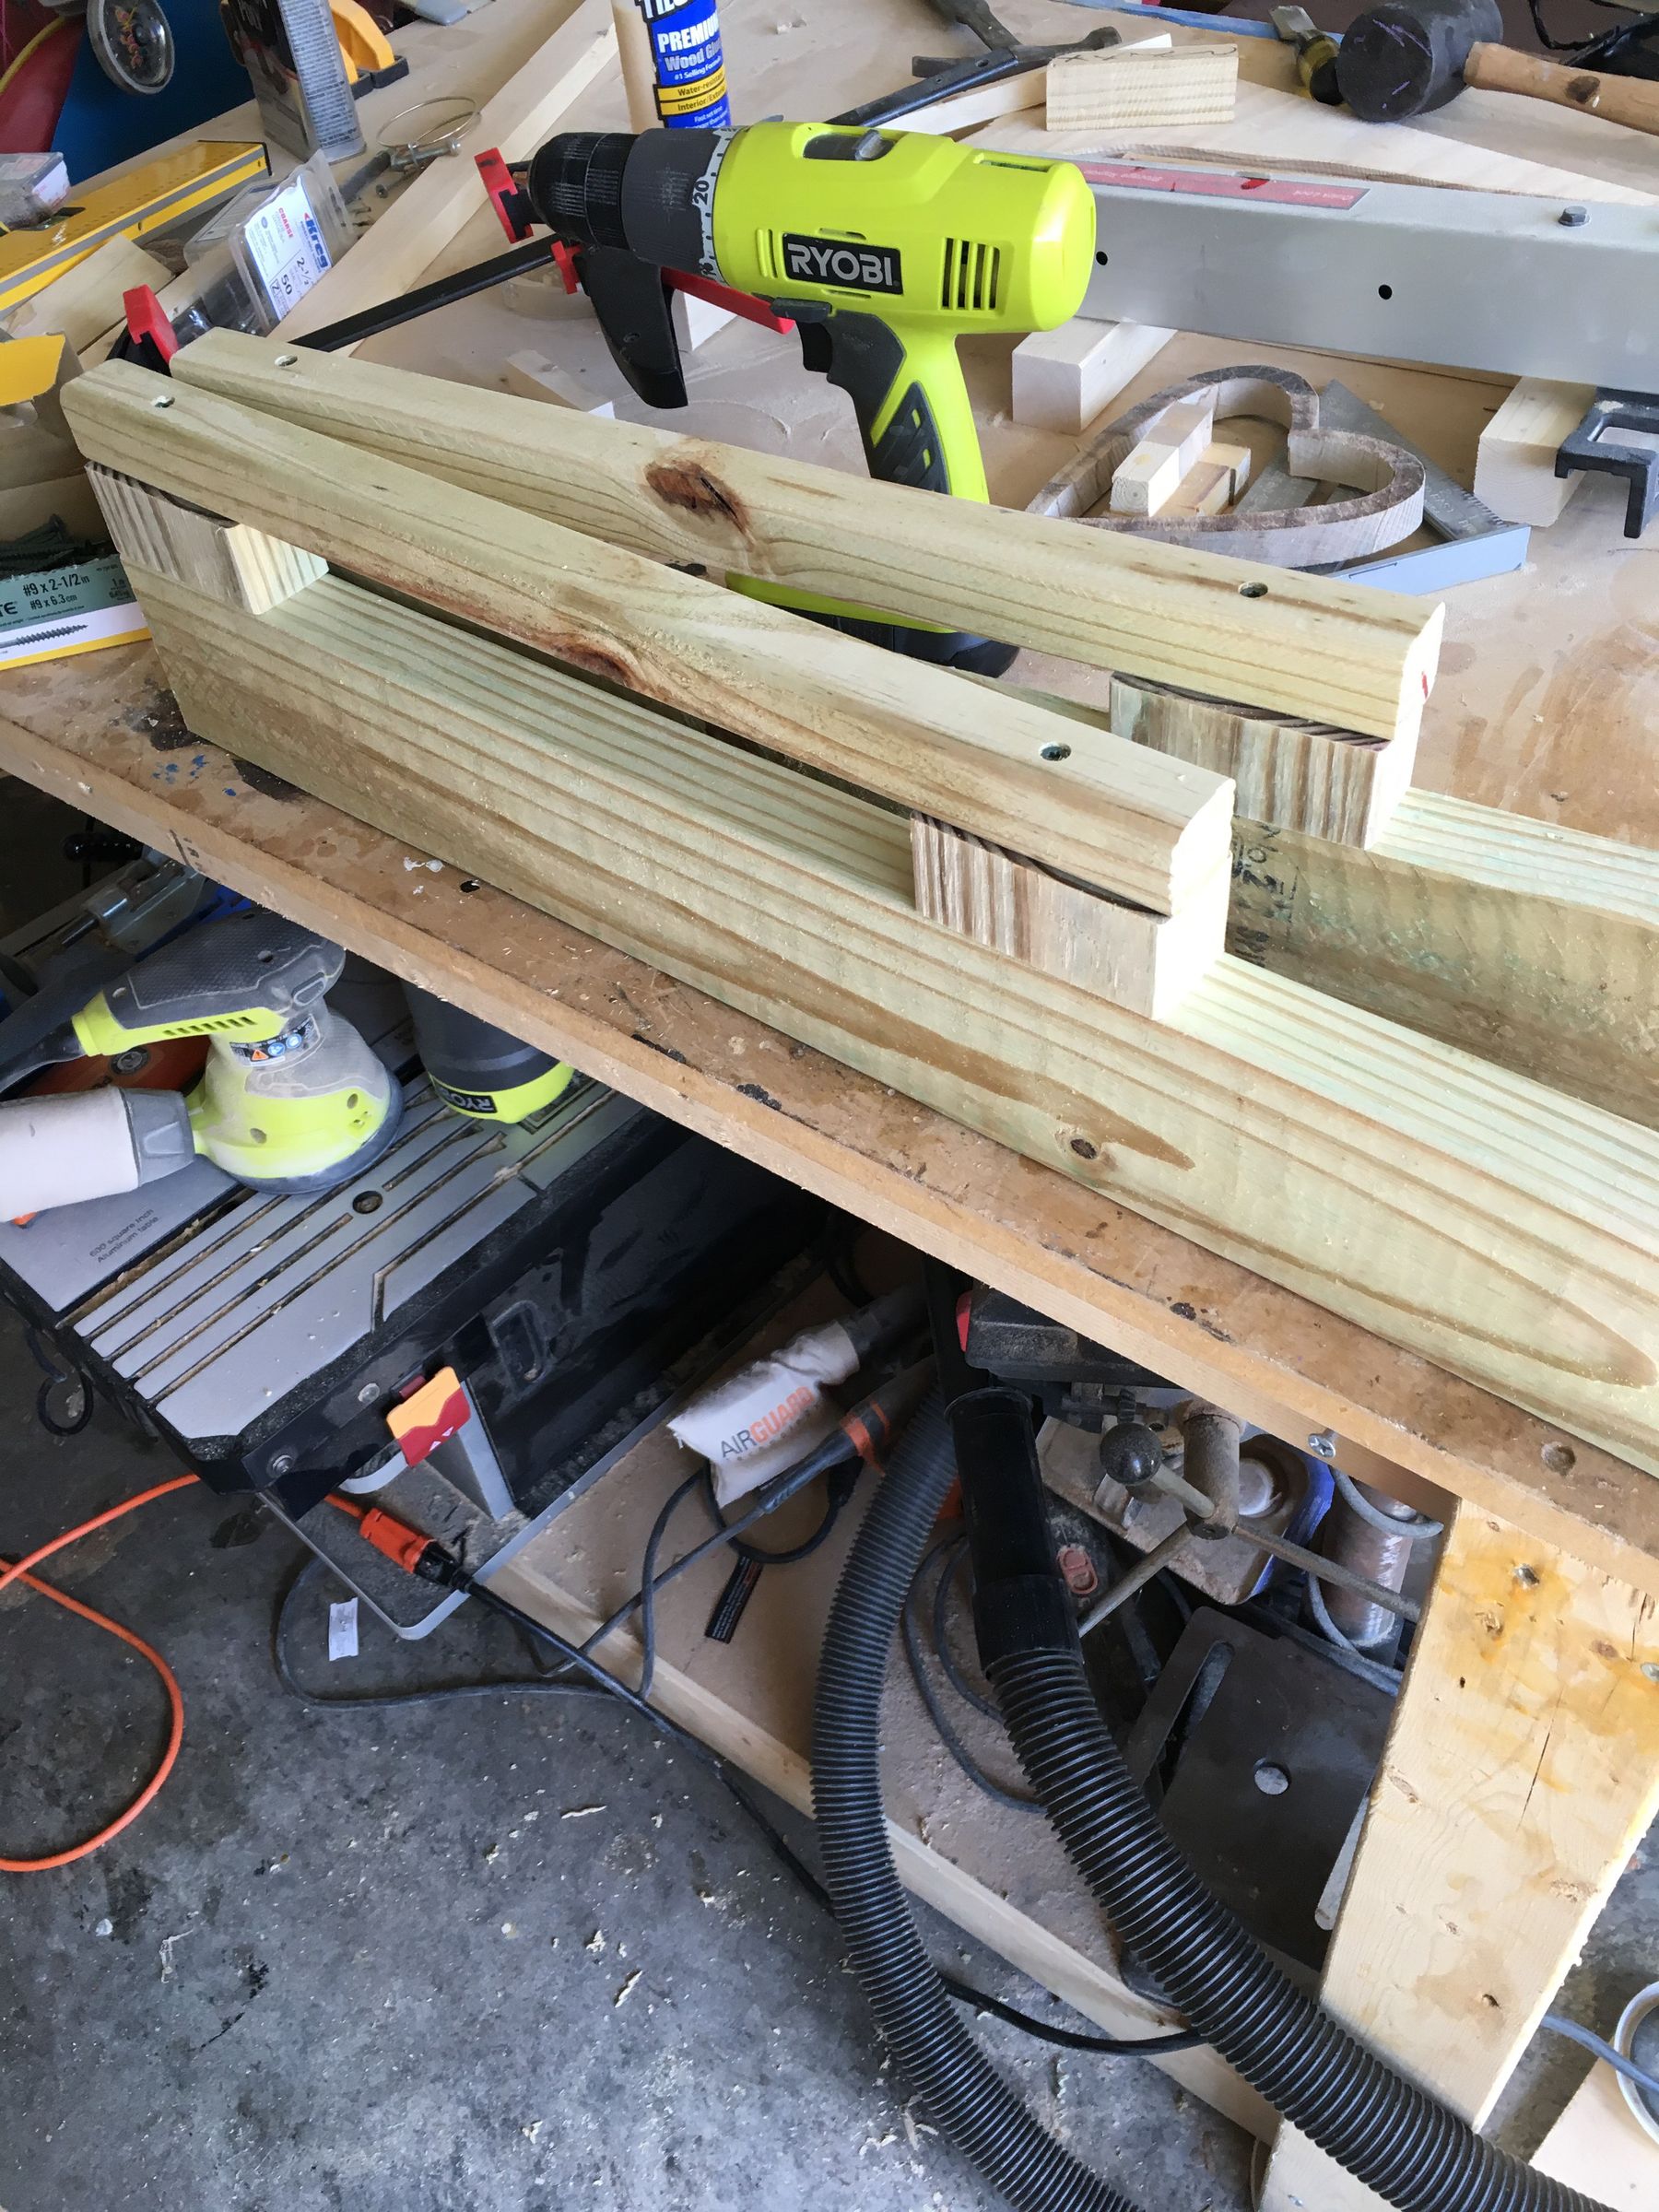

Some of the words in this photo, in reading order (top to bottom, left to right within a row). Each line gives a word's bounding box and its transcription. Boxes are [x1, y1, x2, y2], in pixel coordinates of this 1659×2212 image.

[665, 48, 705, 71] Wood
[693, 180, 709, 206] 20
[306, 218, 329, 268] Kreg
[787, 242, 894, 287] RYOBI
[280, 274, 293, 296] 50
[23, 582, 39, 597] #9
[41, 584, 49, 594] x
[29, 598, 43, 611] #9
[108, 1223, 135, 1244] square
[137, 1217, 159, 1232] table
